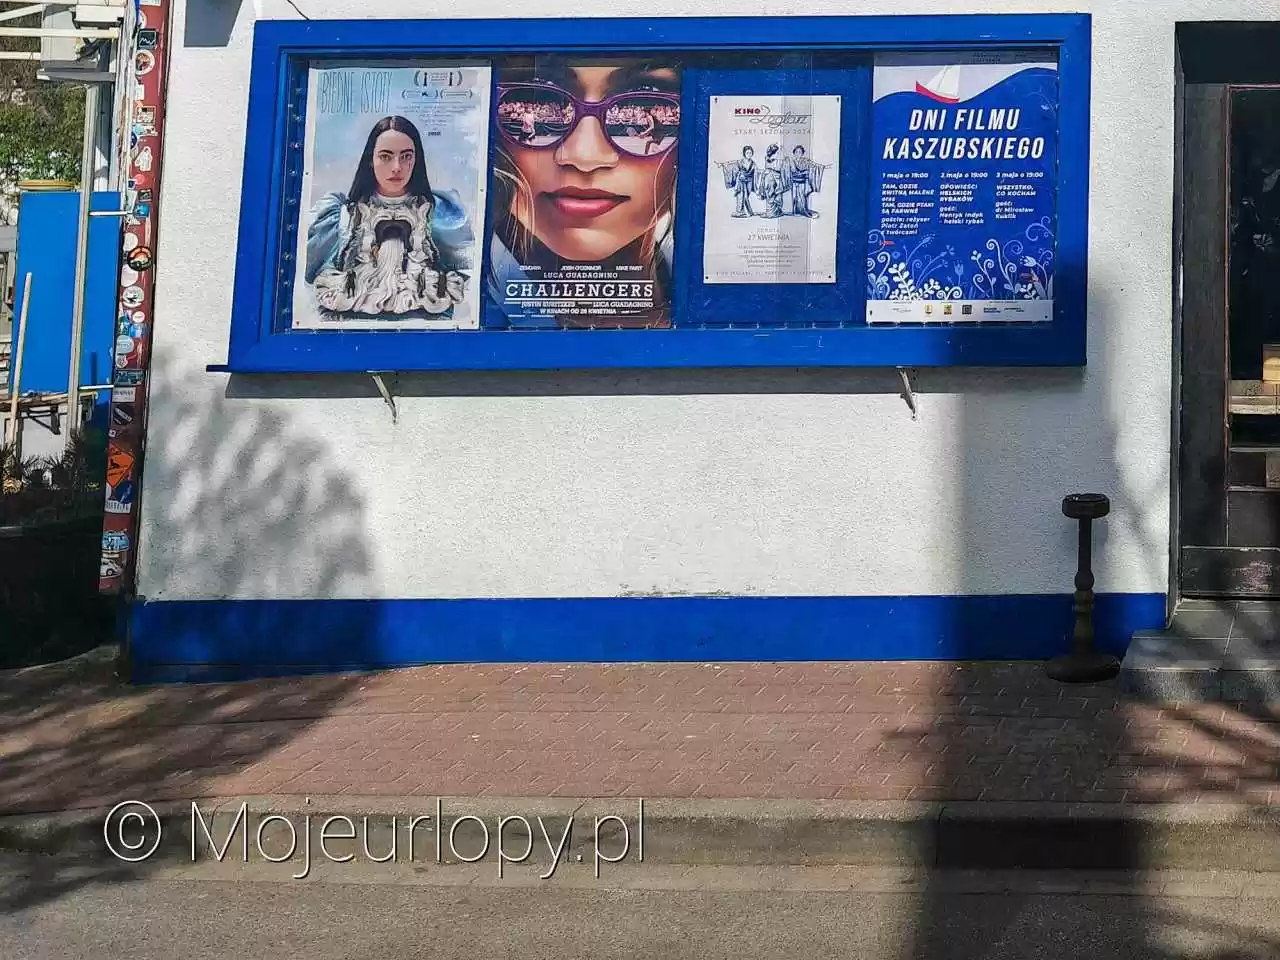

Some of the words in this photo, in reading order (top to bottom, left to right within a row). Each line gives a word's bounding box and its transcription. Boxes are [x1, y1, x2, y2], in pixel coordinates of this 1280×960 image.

[320, 71, 356, 114] BIEDNE
[360, 71, 393, 114] ISTOTY
[909, 108, 948, 131] DNI
[954, 108, 1021, 131] FILMU
[882, 136, 1045, 160] KASZUBSKIEGO
[946, 172, 963, 180] maja
[1002, 172, 1019, 180] maja
[505, 283, 654, 297] CHALLENGERS
